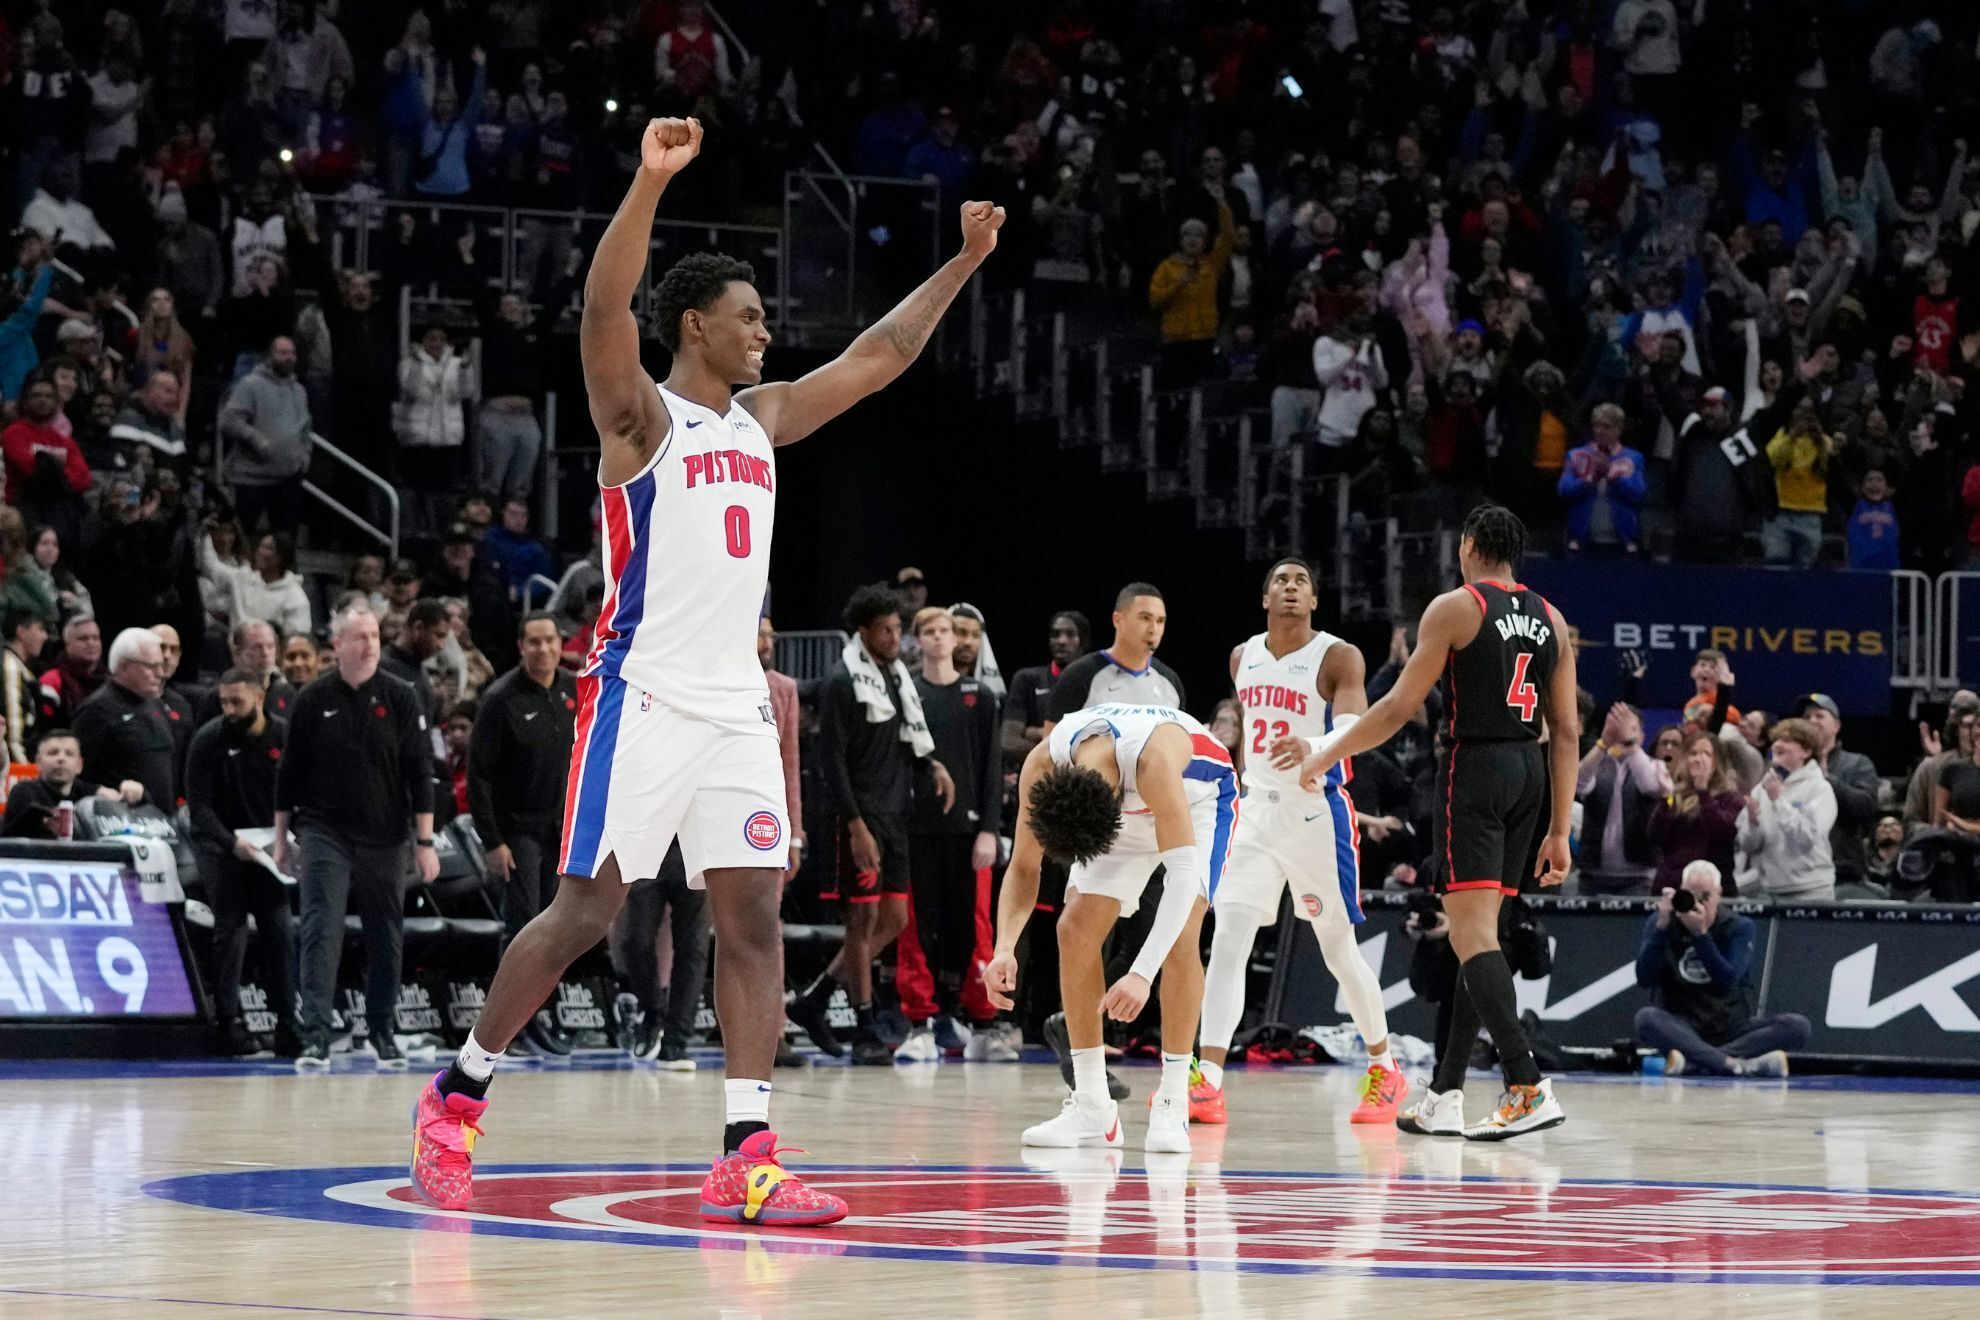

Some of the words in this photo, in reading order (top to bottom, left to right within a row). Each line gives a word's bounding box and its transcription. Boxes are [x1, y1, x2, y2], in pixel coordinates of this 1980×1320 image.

[683, 450, 773, 493] PISTONS
[725, 505, 751, 558] 0
[1613, 622, 1884, 656] BETRIVERS
[1239, 685, 1308, 716] PISTONS
[1506, 652, 1538, 722] 4
[752, 823, 775, 832] DETROIT
[752, 830, 775, 839] PISTONS
[96, 937, 148, 1013] 9
